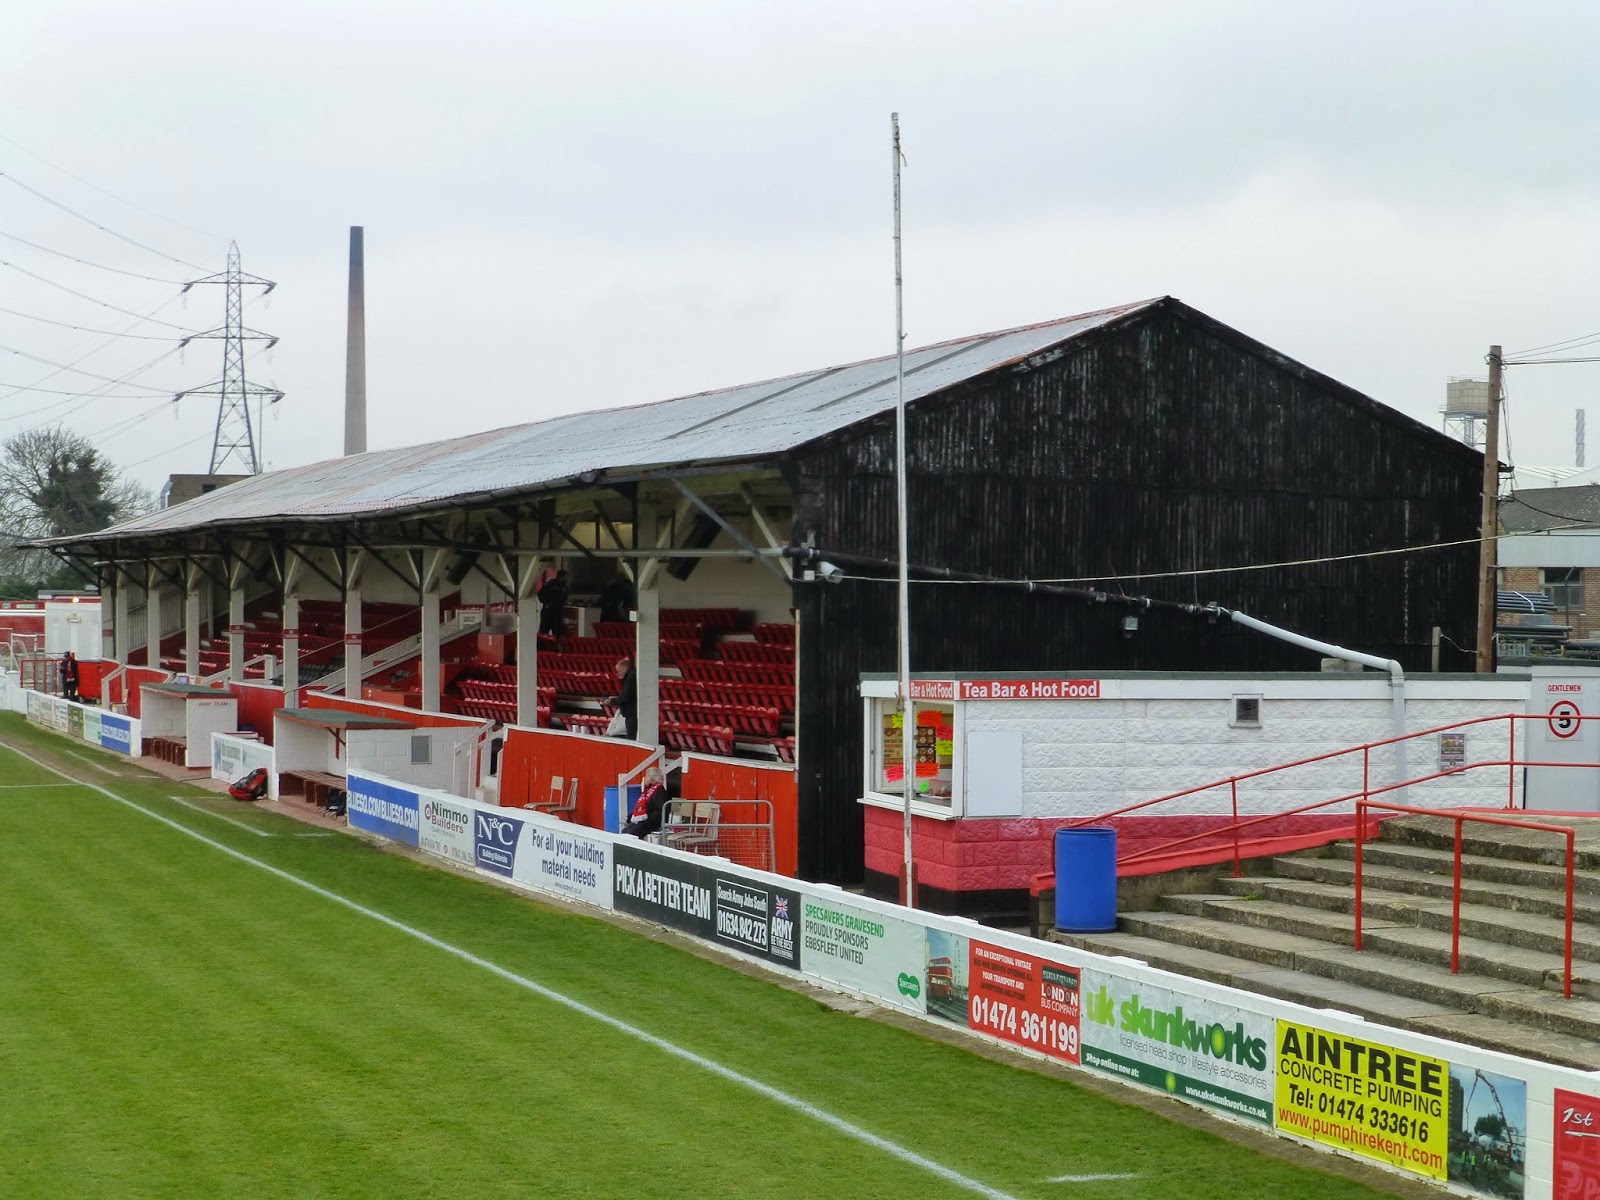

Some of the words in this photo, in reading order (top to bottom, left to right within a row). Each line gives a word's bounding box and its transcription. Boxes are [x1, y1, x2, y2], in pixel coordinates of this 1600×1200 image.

[911, 682, 920, 697] Bar
[921, 685, 926, 697] &
[926, 683, 937, 698] Hot
[937, 683, 953, 698] Food
[963, 682, 988, 698] Tea
[991, 682, 1016, 697] Bar
[1019, 684, 1028, 697] &
[1031, 682, 1058, 697] Hot
[1061, 681, 1097, 697] Food
[1547, 684, 1582, 692] GENTLEMEN
[1558, 711, 1571, 729] 5
[431, 801, 469, 825] Nimmo
[431, 815, 464, 834] Builders
[477, 815, 514, 846] N&C
[532, 829, 544, 849] For
[545, 833, 555, 852] all
[555, 839, 572, 857] your
[574, 839, 605, 870] building
[542, 858, 571, 881] material
[573, 868, 597, 888] needs
[616, 863, 637, 897] PICK
[636, 869, 644, 899] A
[645, 871, 681, 911] BETTER
[681, 882, 711, 921] TEAM
[717, 909, 739, 937] 01634
[739, 916, 753, 942] 842
[753, 920, 768, 946] 273
[771, 916, 794, 941] ARMY
[805, 903, 845, 927] SPECSAVERS
[845, 914, 885, 938] GRAVESEND
[805, 919, 834, 939] PROUDLY
[834, 927, 869, 950] SPONSORS
[783, 939, 794, 951] BEST
[805, 935, 838, 957] EBBSFLEET
[839, 945, 864, 965] UNITED
[975, 947, 984, 957] FOR
[989, 951, 1015, 966] EXCEPTIONAL
[1014, 958, 1032, 971] VINTAGE
[982, 971, 994, 981] YOUR
[993, 974, 1015, 988] TRANSPORT
[1015, 980, 1025, 990] AND
[1041, 983, 1079, 1007] LONDON
[1040, 997, 1051, 1010] BUS
[1051, 1000, 1078, 1018] COMPANY
[972, 994, 1017, 1035] 01474
[1020, 1010, 1078, 1055] 361199
[1086, 985, 1116, 1028] uk
[1120, 994, 1267, 1072] skunkworks
[1085, 1052, 1101, 1067] Shop
[1100, 1058, 1119, 1071] online
[1118, 1064, 1131, 1075] now
[1130, 1067, 1140, 1078] at:
[1120, 1034, 1148, 1053] licensed
[1148, 1042, 1167, 1059] head
[1168, 1049, 1187, 1067] shop
[1191, 1054, 1219, 1076] lifestyle
[1220, 1062, 1267, 1090] accessories
[1280, 1026, 1443, 1098] AINTREE
[1185, 1085, 1267, 1120] www.ukskunkworks.co.uk
[1280, 1057, 1362, 1096] CONCRETE
[1367, 1081, 1443, 1119] PUMPING
[1289, 1082, 1314, 1110] Tel:
[1318, 1092, 1365, 1125] 01474
[1369, 1106, 1430, 1143] 333616
[1562, 1107, 1594, 1127] 1st
[1278, 1107, 1443, 1170] www.pumphirekent.com
